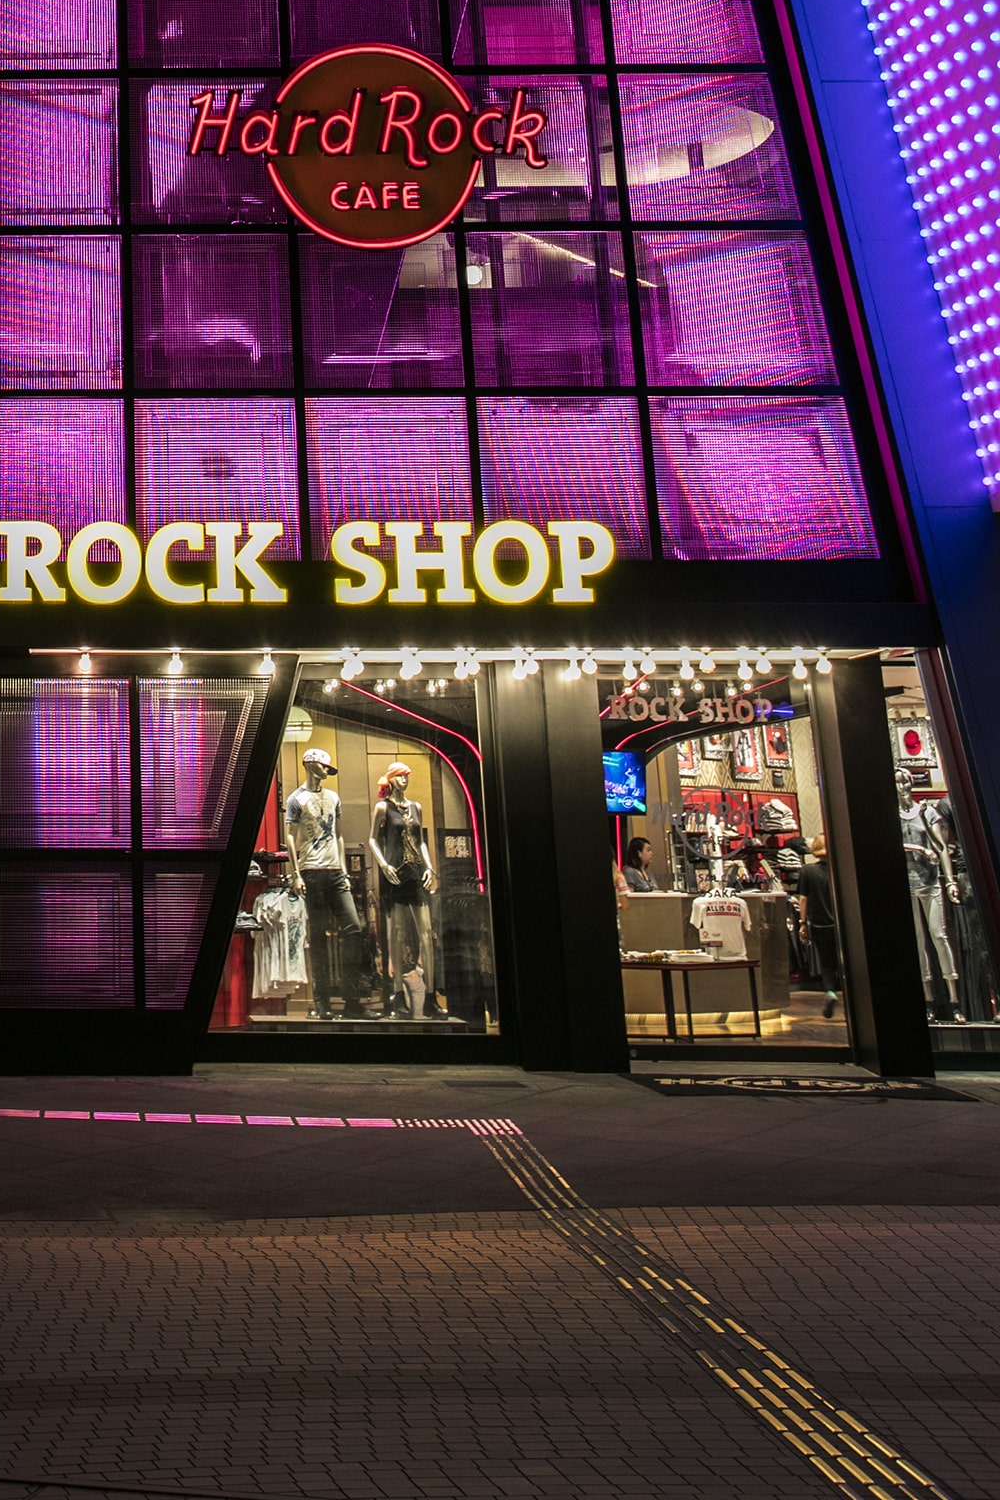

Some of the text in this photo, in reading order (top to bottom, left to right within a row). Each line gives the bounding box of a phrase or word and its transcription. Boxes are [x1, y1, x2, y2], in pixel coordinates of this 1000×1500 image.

[187, 85, 549, 169] Hard Rock
[330, 181, 422, 211] CAFE
[331, 520, 615, 604] SHOP
[606, 694, 773, 725] ROCK SHOP
